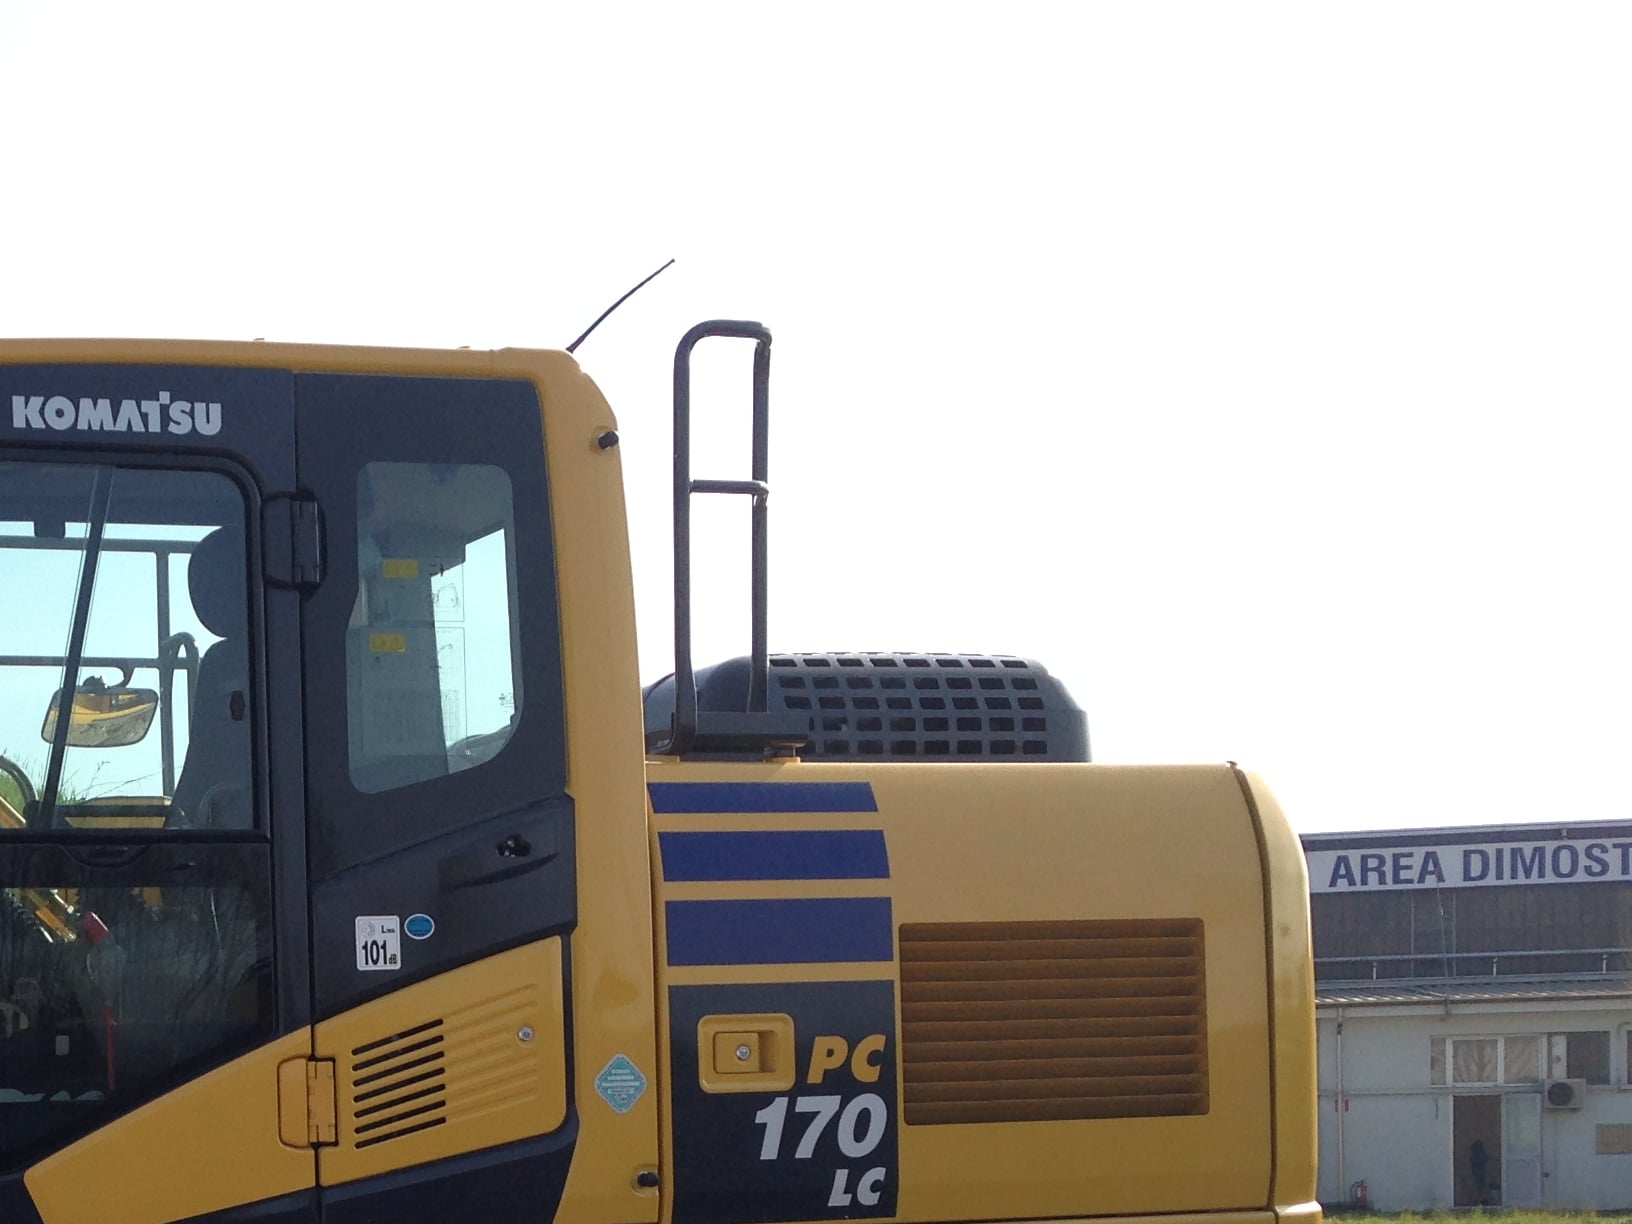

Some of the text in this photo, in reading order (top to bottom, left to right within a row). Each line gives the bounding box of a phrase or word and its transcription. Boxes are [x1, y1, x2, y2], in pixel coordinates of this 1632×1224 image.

[12, 391, 222, 435] KOMATSU
[1328, 842, 1632, 888] AREA DIMOST
[362, 940, 388, 966] 101
[806, 1034, 886, 1084] PC
[755, 1093, 888, 1160] 170
[827, 1167, 886, 1207] LC
